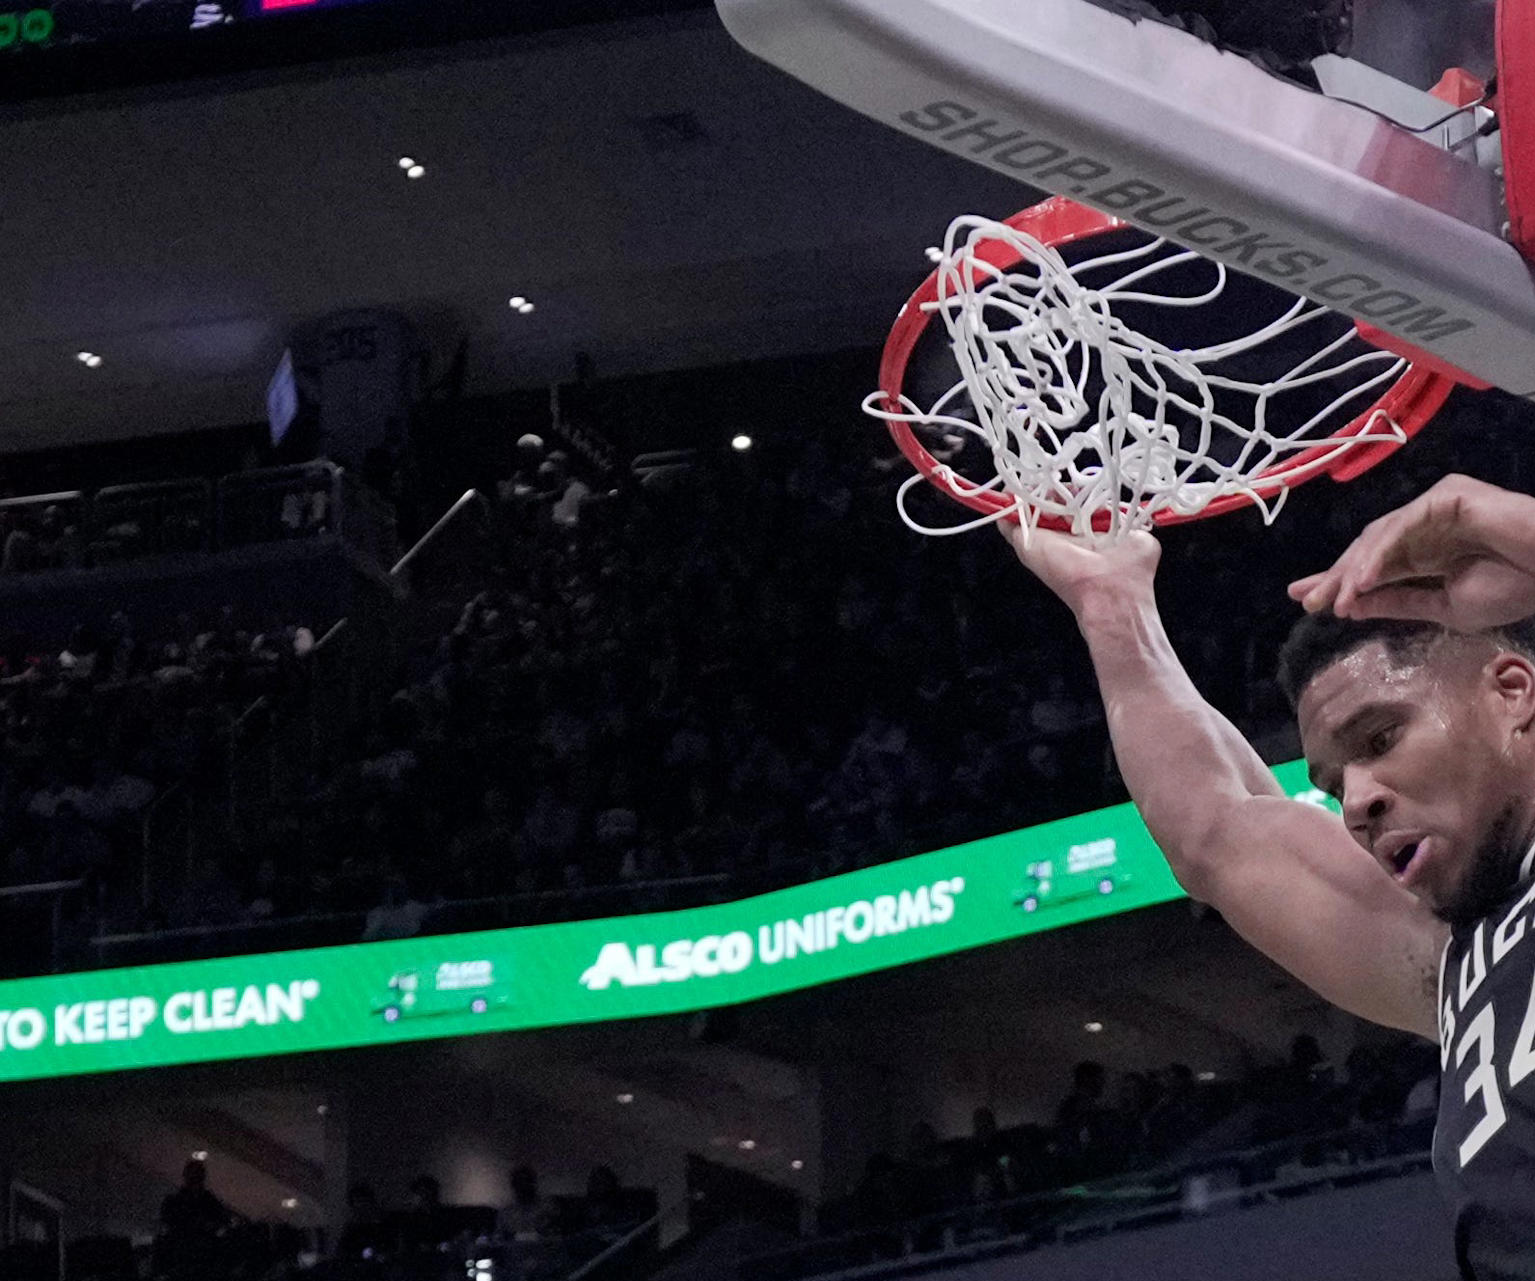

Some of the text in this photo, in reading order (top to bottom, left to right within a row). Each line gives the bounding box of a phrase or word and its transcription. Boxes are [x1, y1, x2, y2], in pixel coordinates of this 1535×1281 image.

[900, 100, 1476, 343] SHOP.BUCKS.COM
[578, 930, 754, 990] ALSCO
[758, 883, 958, 965] UNIFORMS
[54, 997, 157, 1046] KEEP
